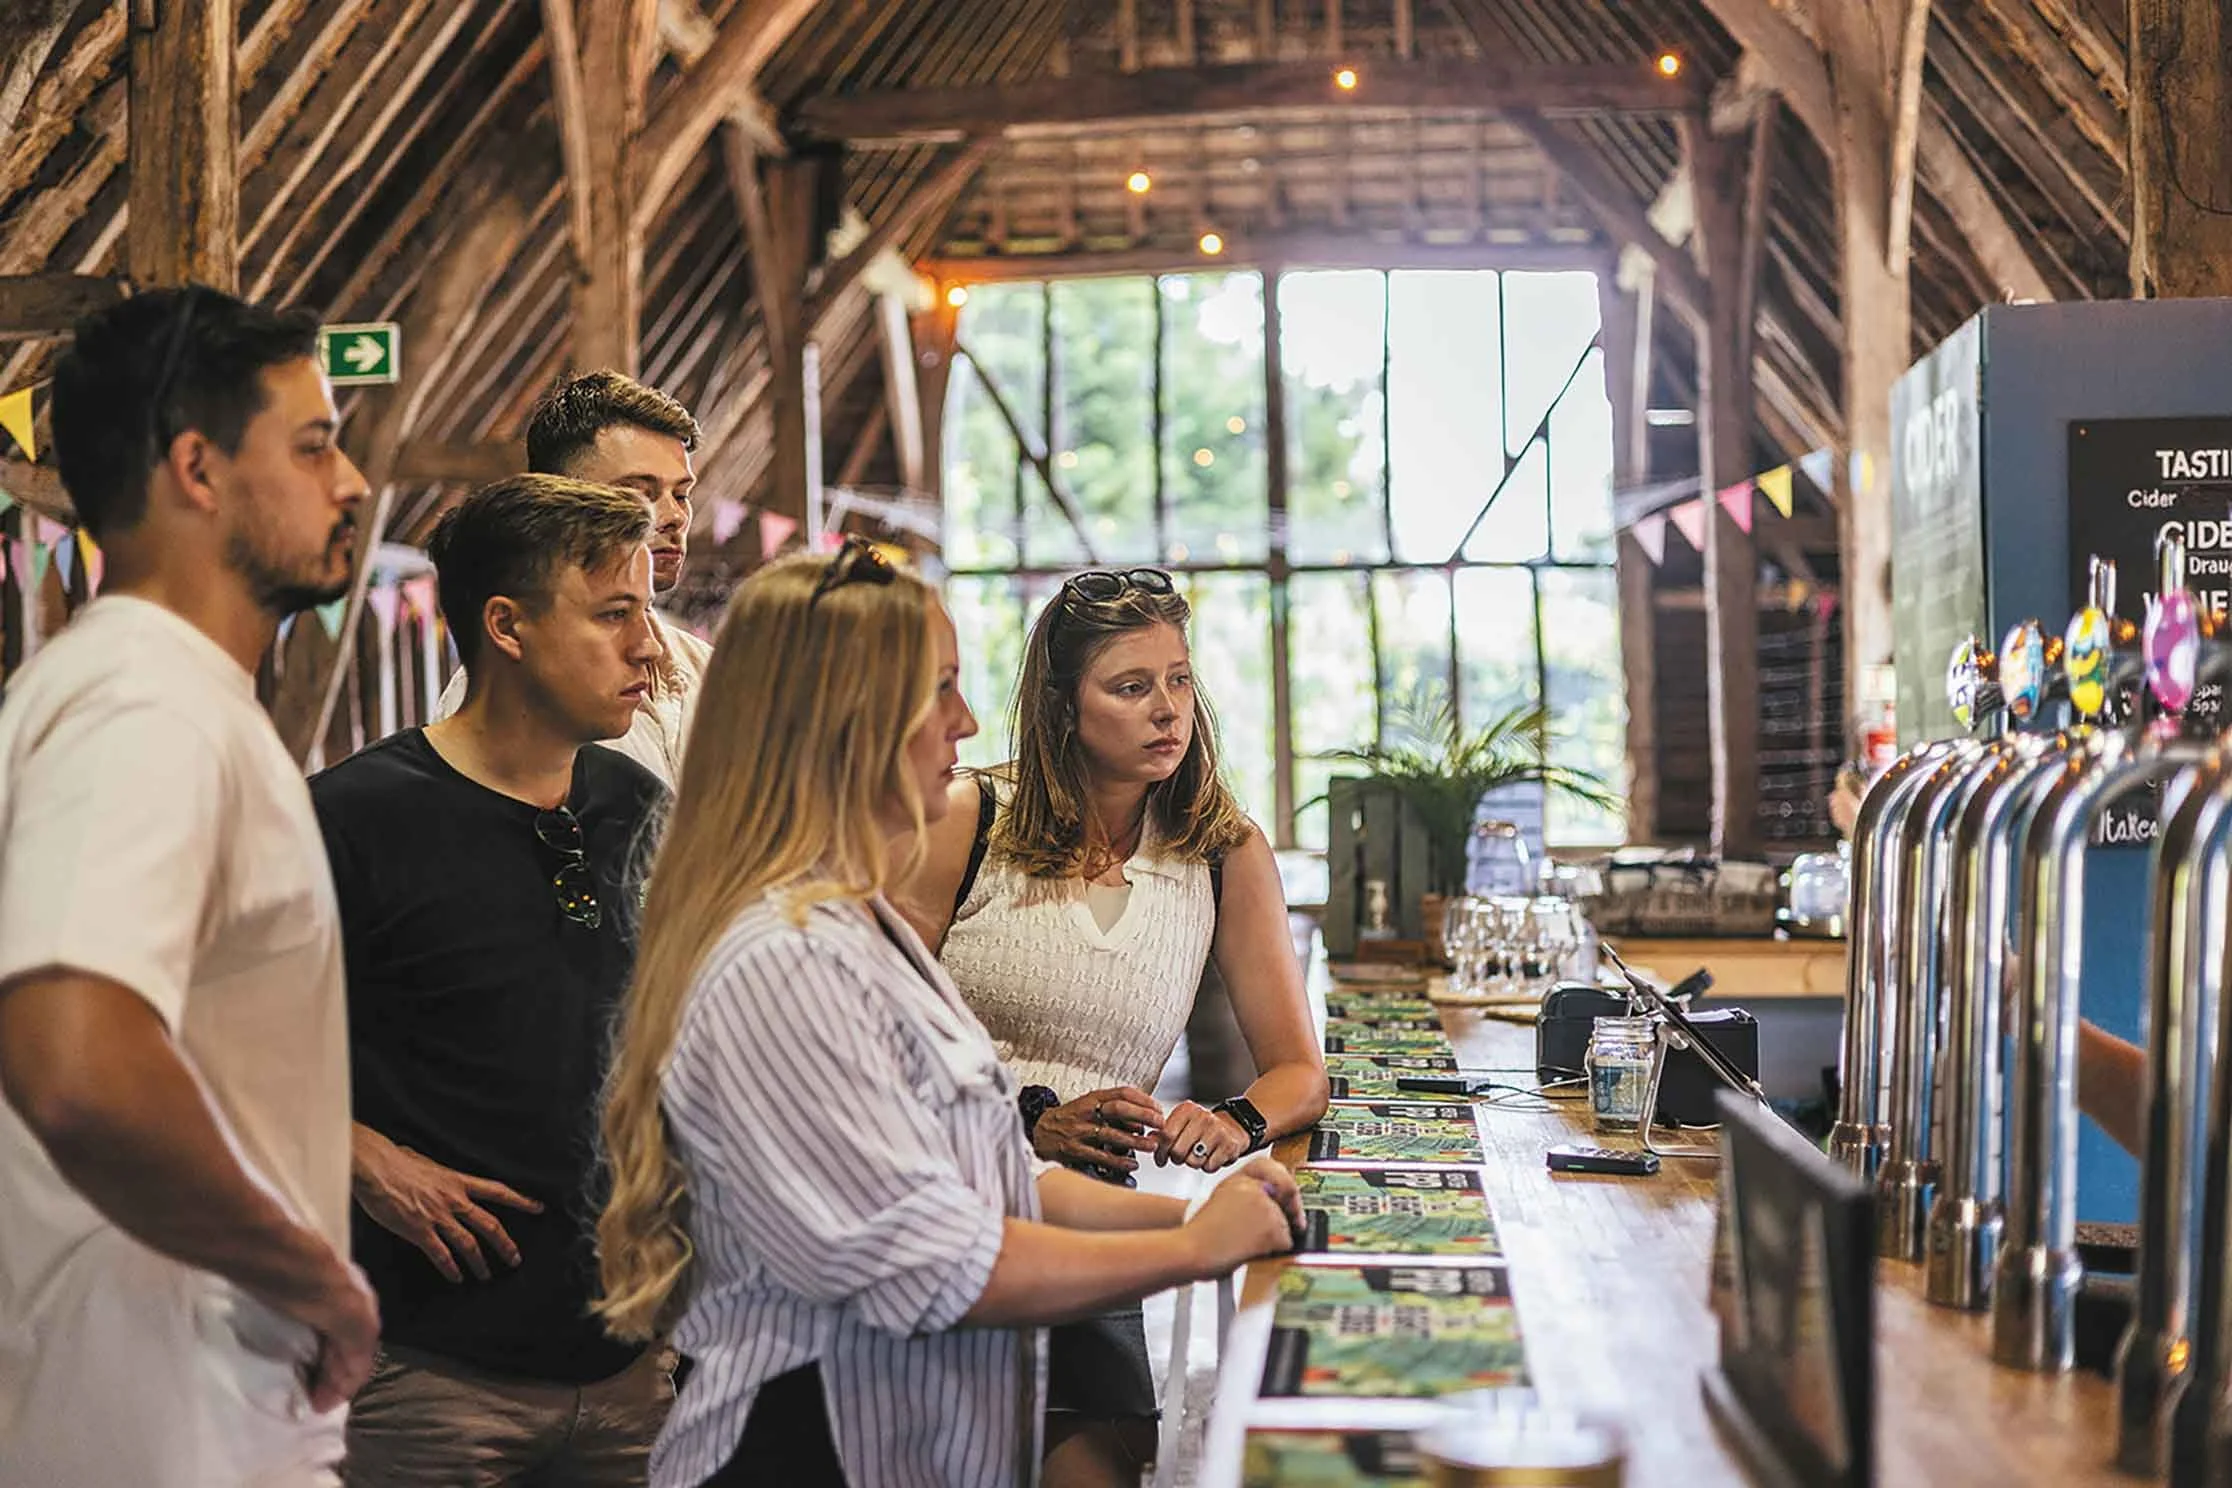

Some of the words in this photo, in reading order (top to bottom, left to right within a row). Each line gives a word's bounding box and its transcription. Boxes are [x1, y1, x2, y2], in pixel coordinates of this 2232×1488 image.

[2155, 448, 2232, 478] TASTI
[2127, 488, 2177, 508] Cider
[2189, 556, 2232, 575] Drau
